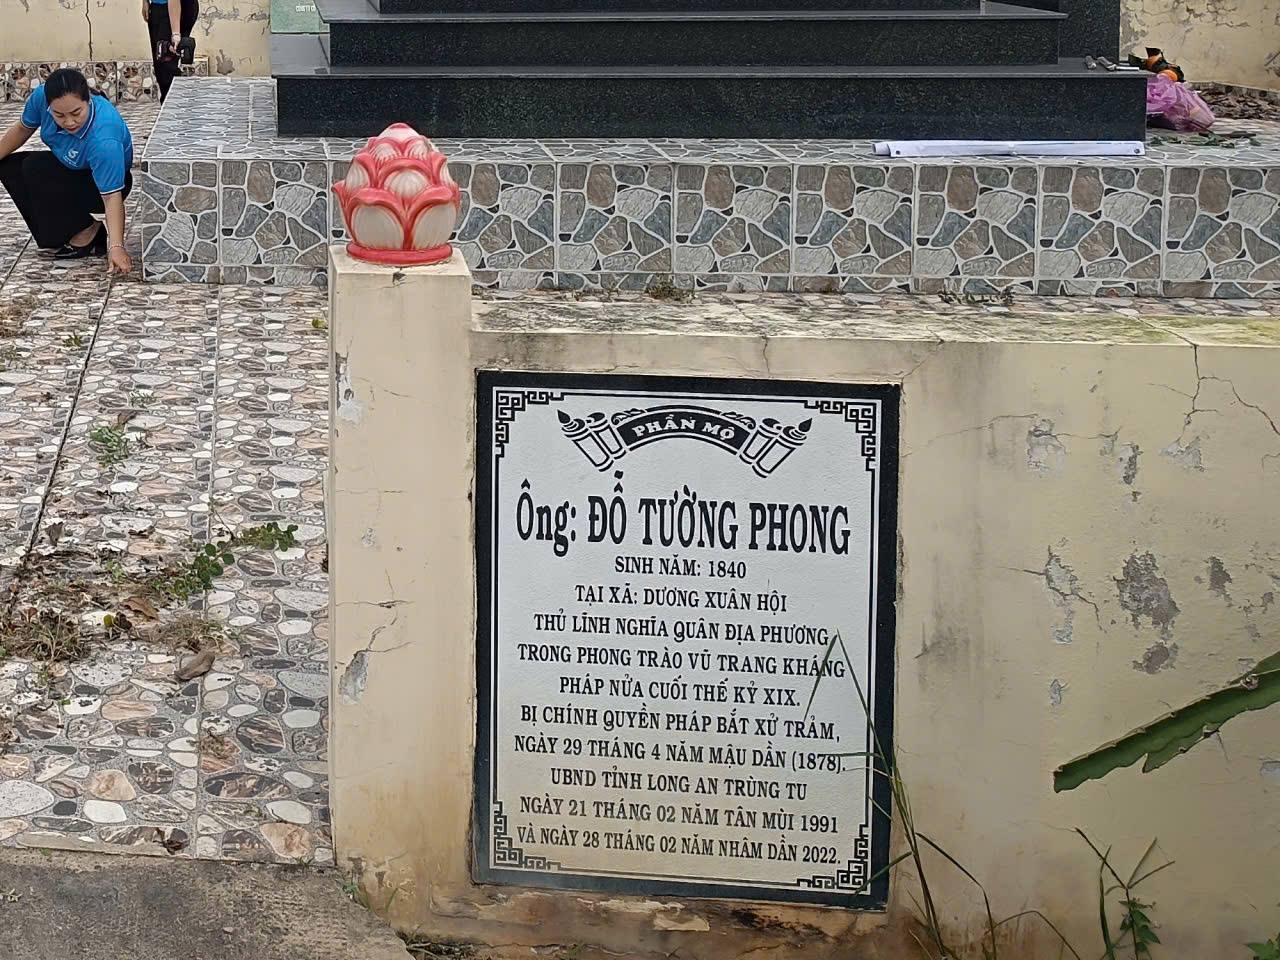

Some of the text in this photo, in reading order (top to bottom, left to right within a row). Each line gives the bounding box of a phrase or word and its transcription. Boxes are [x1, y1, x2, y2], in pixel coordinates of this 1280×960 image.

[701, 422, 735, 441] MỘ
[516, 470, 851, 557] Ông: ĐỖ TƯỜNG PHONG
[615, 554, 746, 578] SINH NĂM: 1840
[575, 583, 787, 615] TẠI XÃ: DƯƠNG XUÂN HỘI
[534, 608, 829, 646] THỦ LĨNH NGHĨA QUÂN ĐỊA PHƯƠNG
[517, 643, 846, 678] TRONG PHONG TRÀO VŨ TRANG KHÁNG
[559, 673, 800, 706] PHÁP NỬA CUỐI THẾ KỶ XIX.
[521, 703, 840, 742] BỊ CHÍNH QUYỀN PHÁP BẮT XỬ TRẢM,
[514, 732, 846, 774] NGÀY 29 THÁNG 4 NĂM MẬU DẦN (1878).
[551, 765, 807, 800] UBND TỈNH LONG AN TRÙNG TU
[520, 793, 838, 833] NGÀY 21 THÁNG 02 NĂM TÂN MÙI 1991
[517, 823, 841, 864] VÀ NGÀY 28 THÁNG 02 NĂM NHÂM DẦN 2022.
